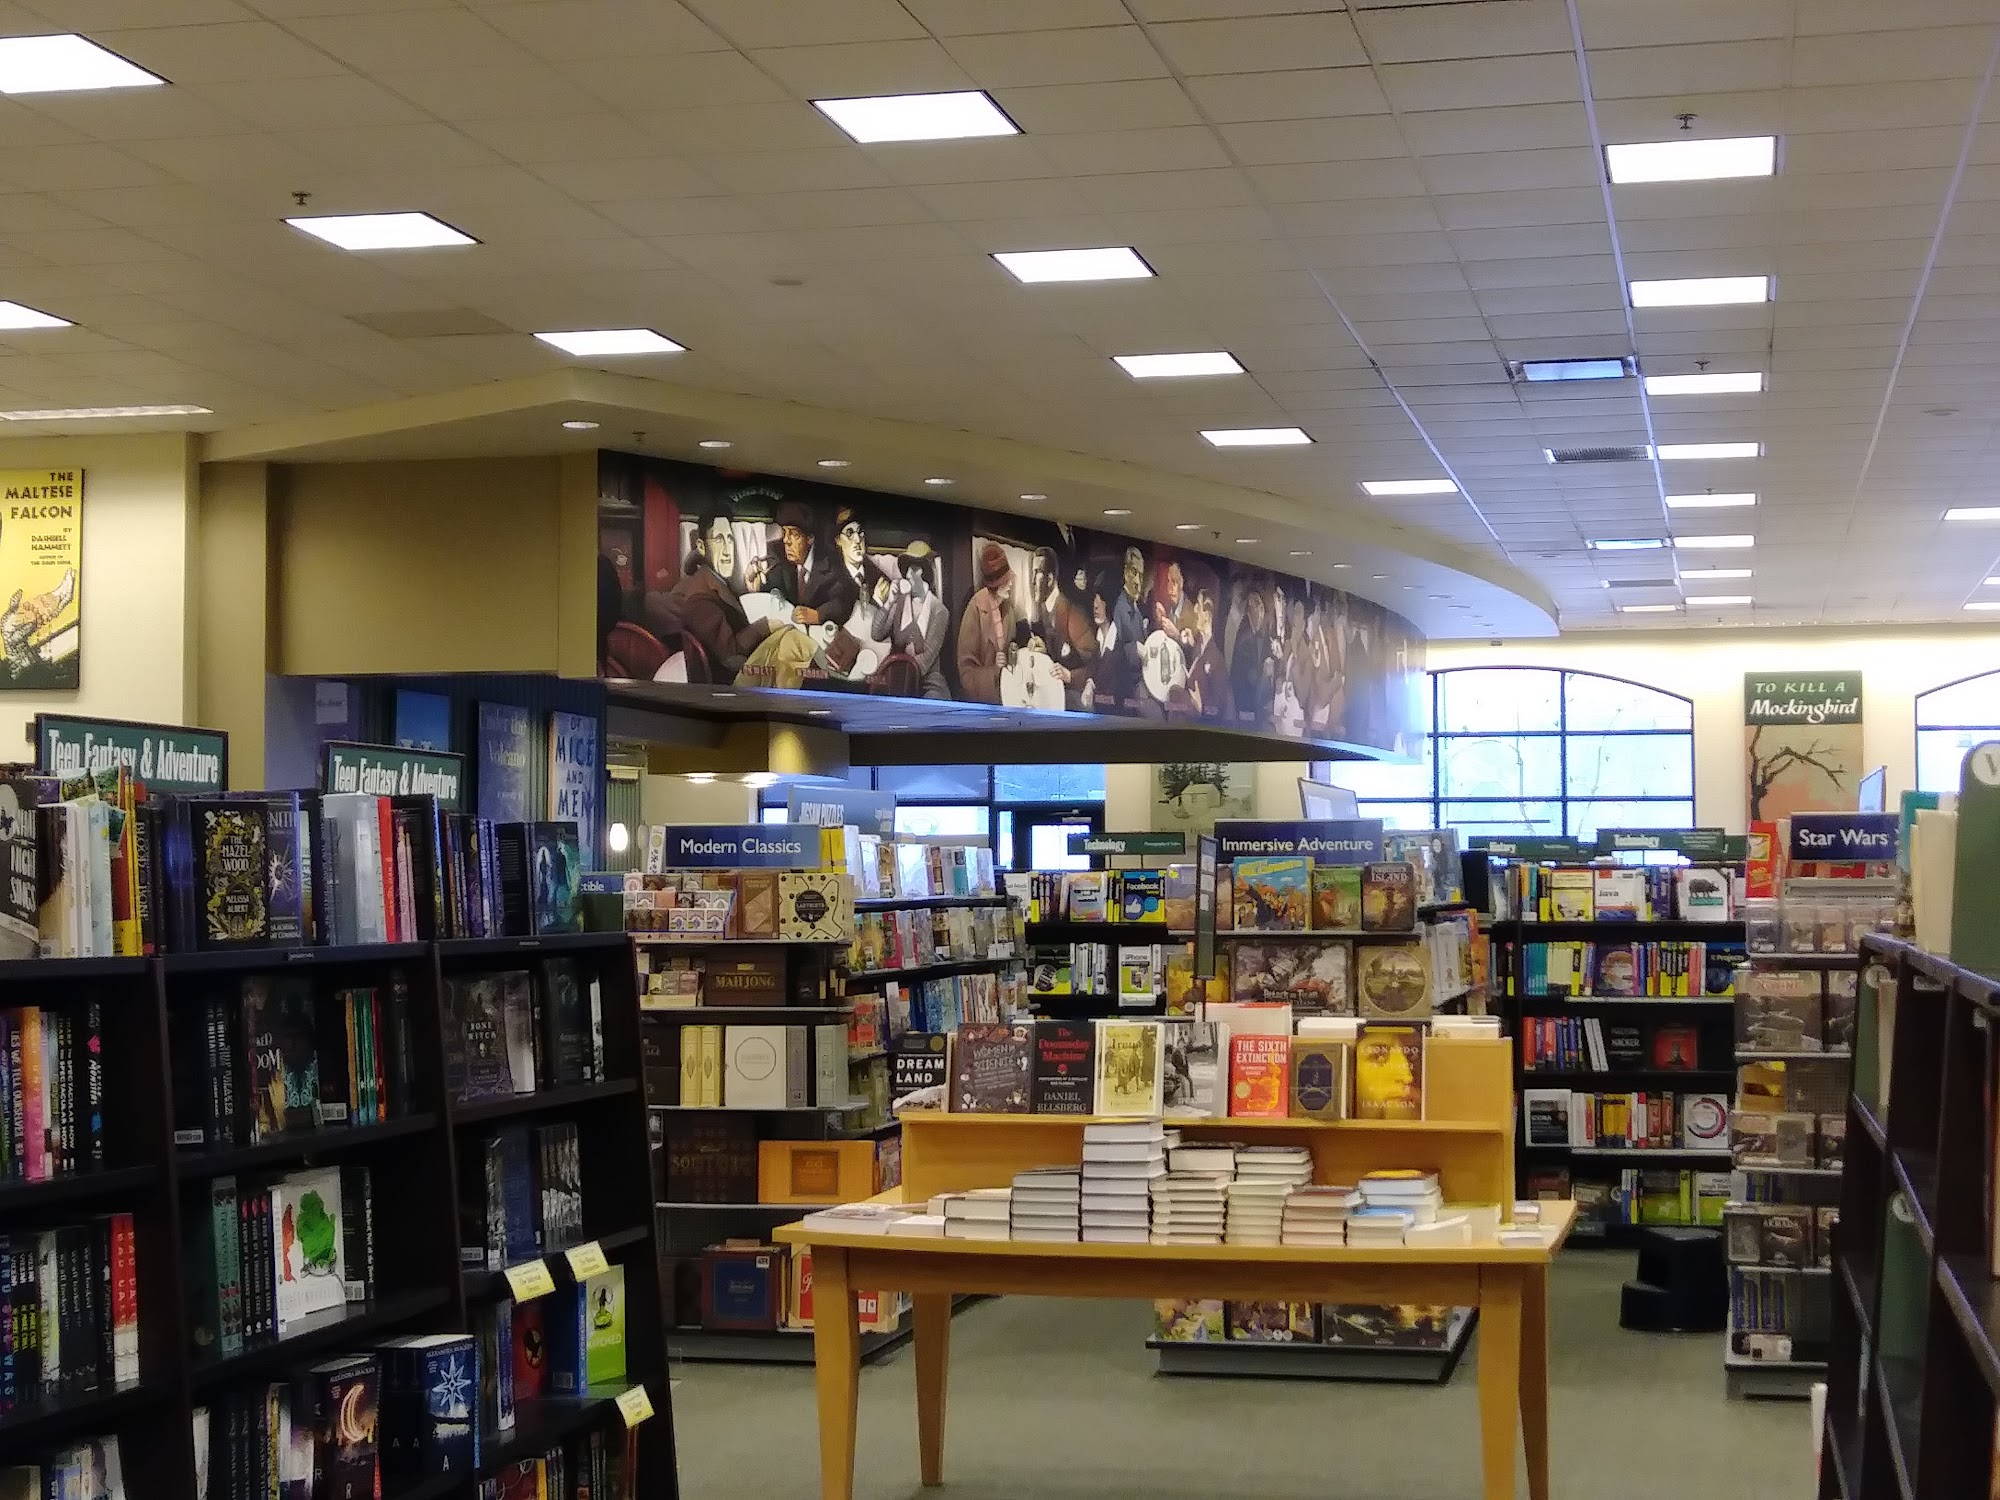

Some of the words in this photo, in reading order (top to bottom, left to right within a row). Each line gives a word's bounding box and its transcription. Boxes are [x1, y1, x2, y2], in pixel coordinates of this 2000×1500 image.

[50, 472, 74, 482] THE
[5, 486, 73, 499] MALTESE
[10, 506, 73, 519] FALCON
[1755, 682, 1777, 693] TO
[1784, 682, 1829, 693] KILL
[1834, 681, 1847, 693] A
[1750, 697, 1858, 724] Mockingbird
[570, 717, 582, 731] OF
[48, 729, 81, 771] Teen
[84, 732, 137, 778] Fantasy
[140, 737, 154, 780] &
[156, 738, 219, 784] Adventure
[555, 735, 595, 767] MICE
[333, 755, 357, 793] Teen
[359, 757, 398, 797] Fantasy
[399, 760, 410, 797] &
[411, 761, 457, 801] Adventure
[566, 769, 584, 785] AND
[557, 788, 596, 818] MEN
[230, 836, 244, 845] THE
[1222, 837, 1294, 851] Immersive
[1298, 836, 1374, 851] Adventure
[1799, 829, 1836, 846] Star
[1840, 829, 1889, 846] Wars
[222, 845, 251, 858] HAZEL
[680, 838, 737, 854] Modern
[742, 838, 802, 854] Classics
[1083, 838, 1127, 853] Technology
[222, 858, 250, 872] WOOD
[1371, 872, 1409, 883] ISLAND
[1126, 882, 1159, 891] Facebook
[1125, 953, 1148, 961] iPhone
[715, 974, 775, 989] MAHJONG
[467, 1031, 497, 1041] WITCH
[1058, 1027, 1074, 1038] The
[1038, 1039, 1090, 1051] Doomsday
[1236, 1040, 1254, 1052] THE
[1258, 1040, 1287, 1052] SIXTH
[1362, 1045, 1420, 1056] LEONARDO
[1042, 1051, 1087, 1062] Machine
[1235, 1052, 1287, 1064] EXTINCTION
[896, 1058, 944, 1070] DREAM
[88, 1059, 98, 1106] MONSTERS
[896, 1072, 933, 1084] LAND
[1043, 1092, 1081, 1102] DANIEL
[1037, 1102, 1087, 1113] ELLSBERG
[1361, 1100, 1416, 1109] ISAACSON
